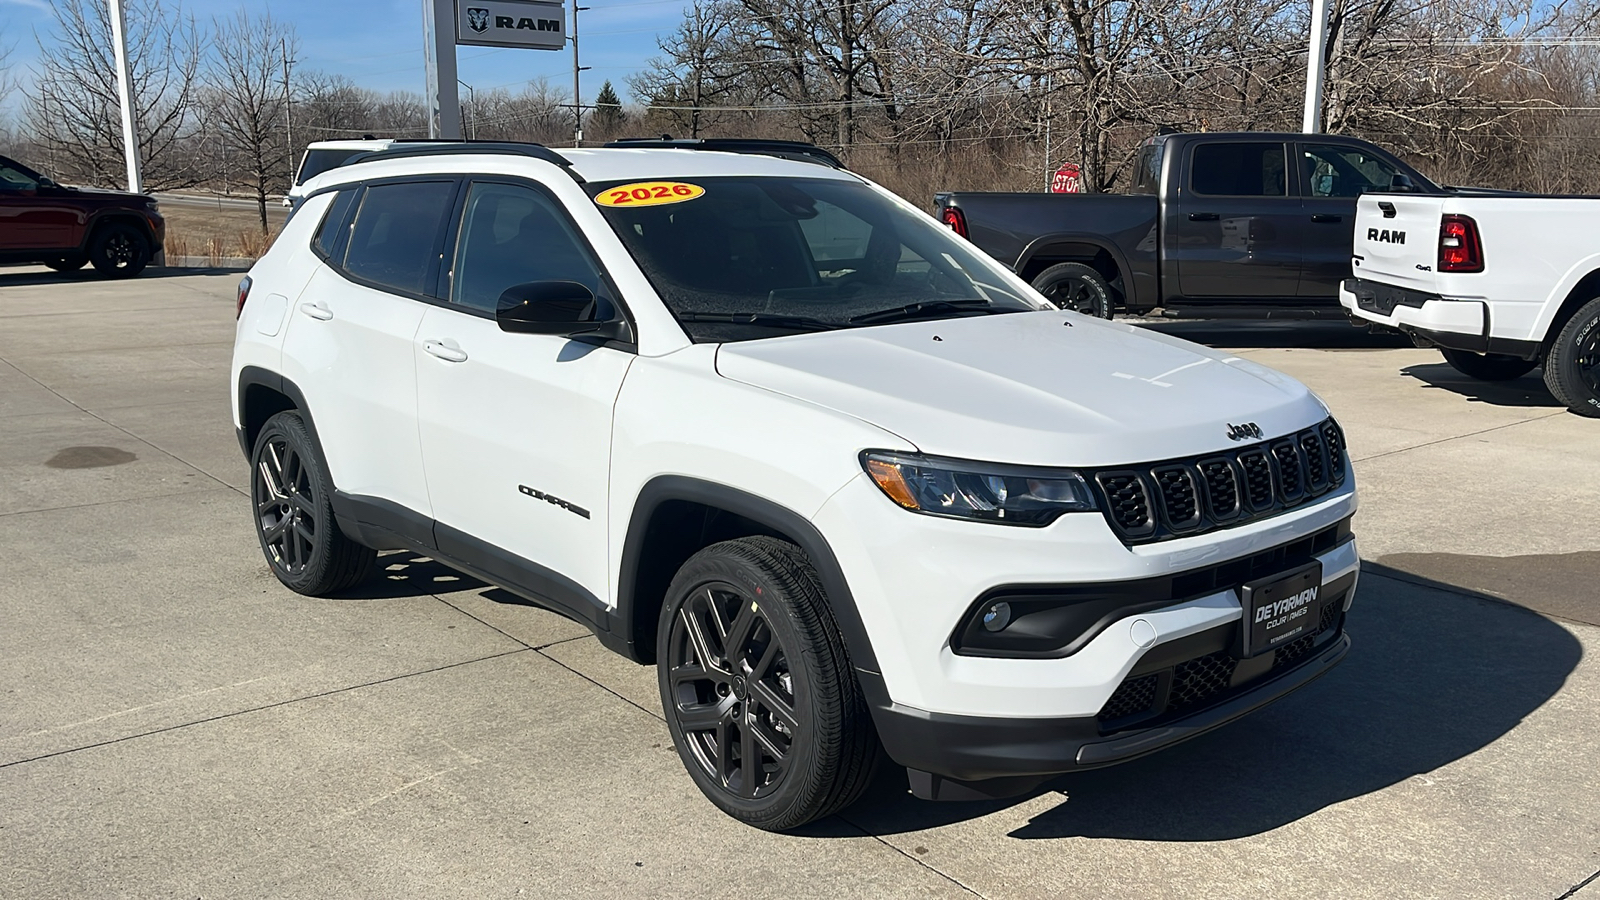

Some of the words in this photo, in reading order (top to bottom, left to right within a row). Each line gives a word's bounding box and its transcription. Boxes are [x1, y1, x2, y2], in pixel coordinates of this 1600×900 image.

[495, 15, 560, 32] RAM
[610, 185, 693, 204] 2026
[1367, 227, 1406, 245] RAM
[1226, 422, 1264, 441] Jeep
[1255, 586, 1318, 623] DEYARMAN
